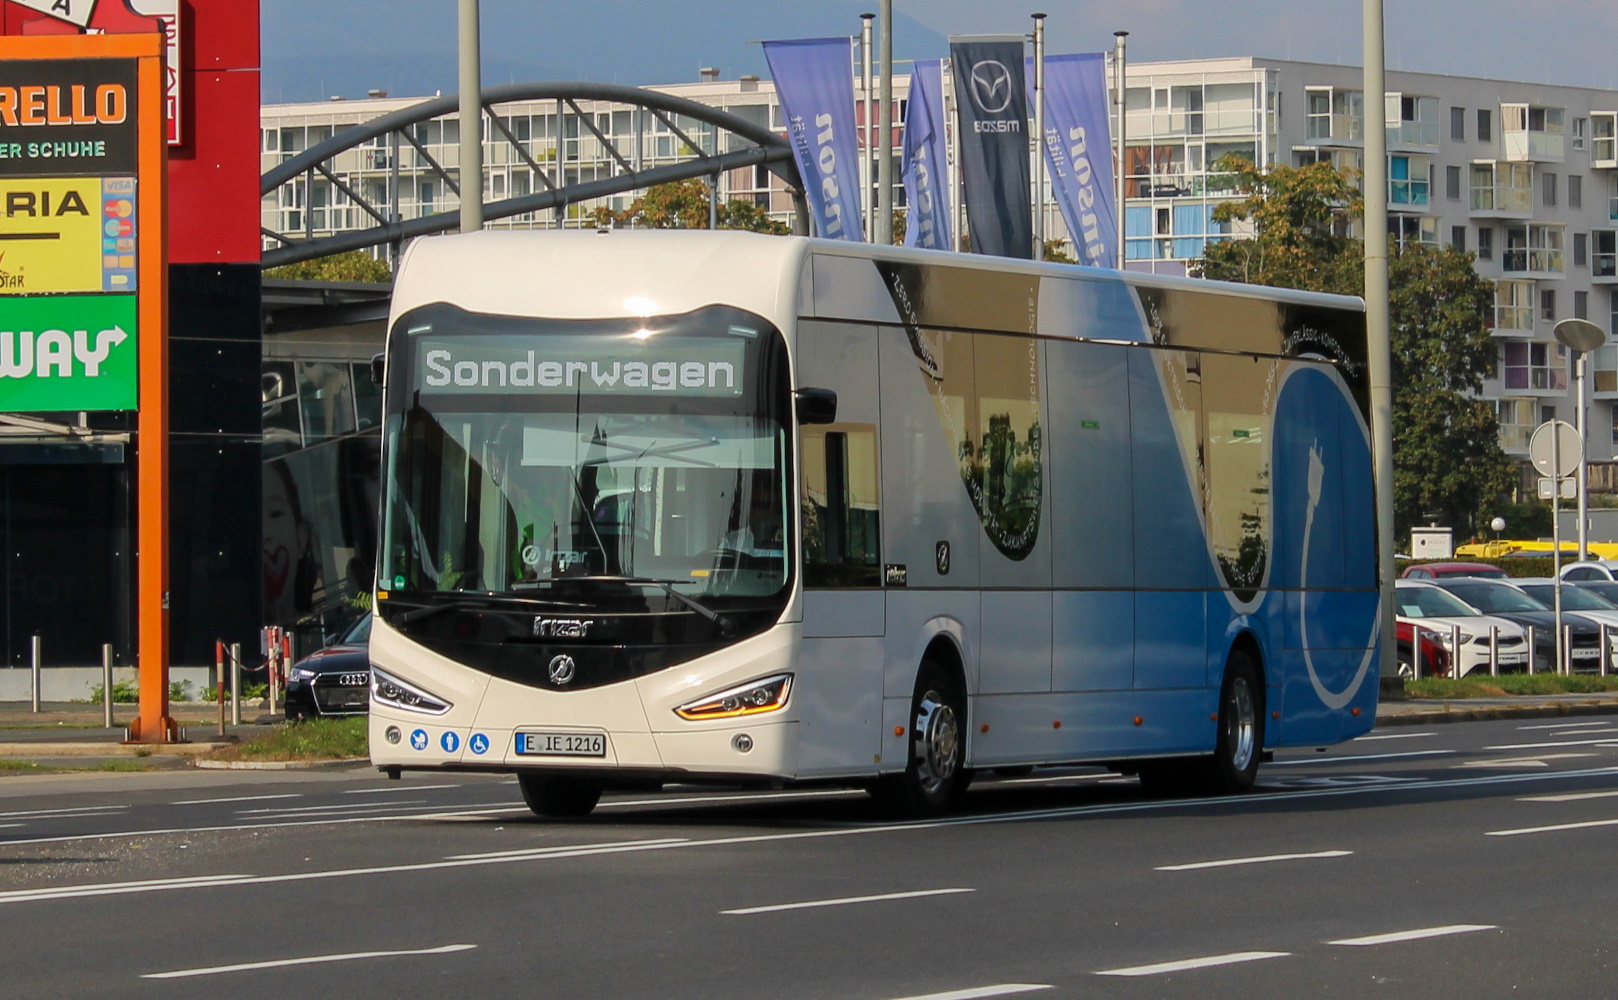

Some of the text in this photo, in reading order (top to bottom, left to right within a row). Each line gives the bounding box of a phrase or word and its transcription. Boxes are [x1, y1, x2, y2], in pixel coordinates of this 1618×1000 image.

[0, 84, 127, 126] RELLO
[27, 141, 106, 158] SCHUHE
[107, 181, 132, 190] VISA
[6, 190, 90, 217] RIA
[893, 274, 911, 315] ZERO
[0, 325, 128, 379] WAY
[426, 350, 734, 390] Sonderwagen
[526, 736, 601, 752] E IE 1216
